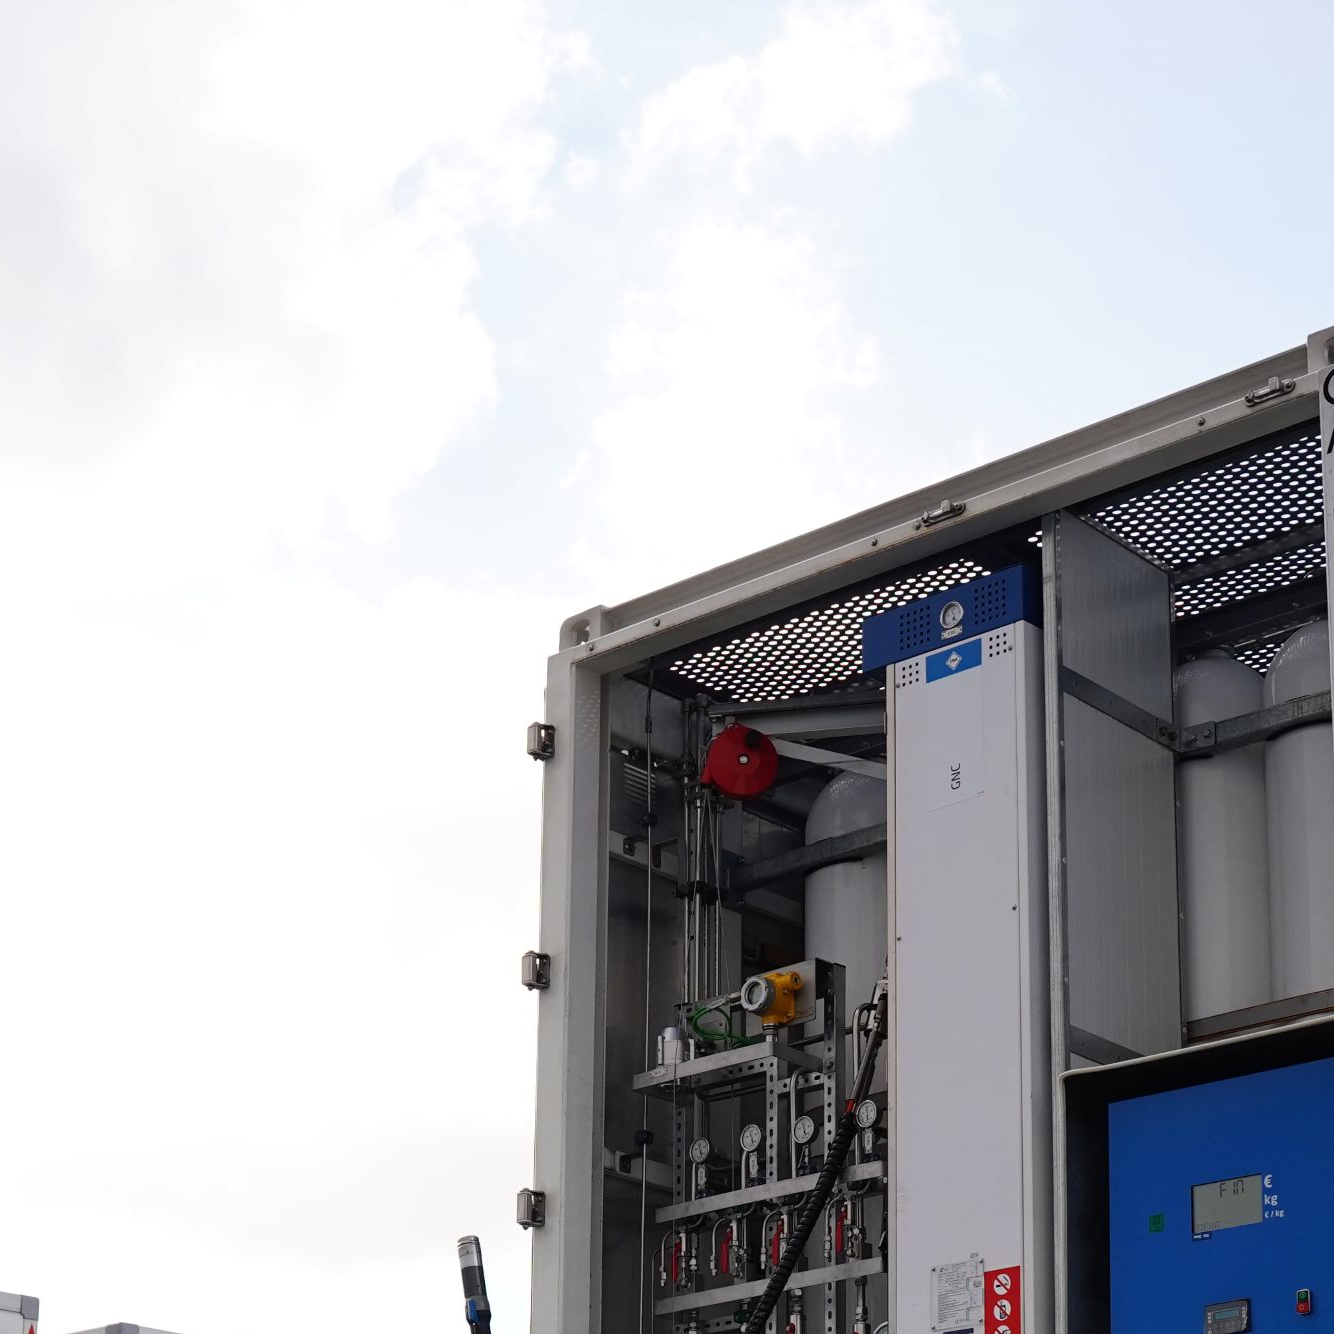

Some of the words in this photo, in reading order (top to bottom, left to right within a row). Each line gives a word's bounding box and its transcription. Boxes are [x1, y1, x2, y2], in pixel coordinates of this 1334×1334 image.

[950, 763, 961, 790] GNC
[1264, 1175, 1273, 1188] €
[1264, 1194, 1278, 1206] kg
